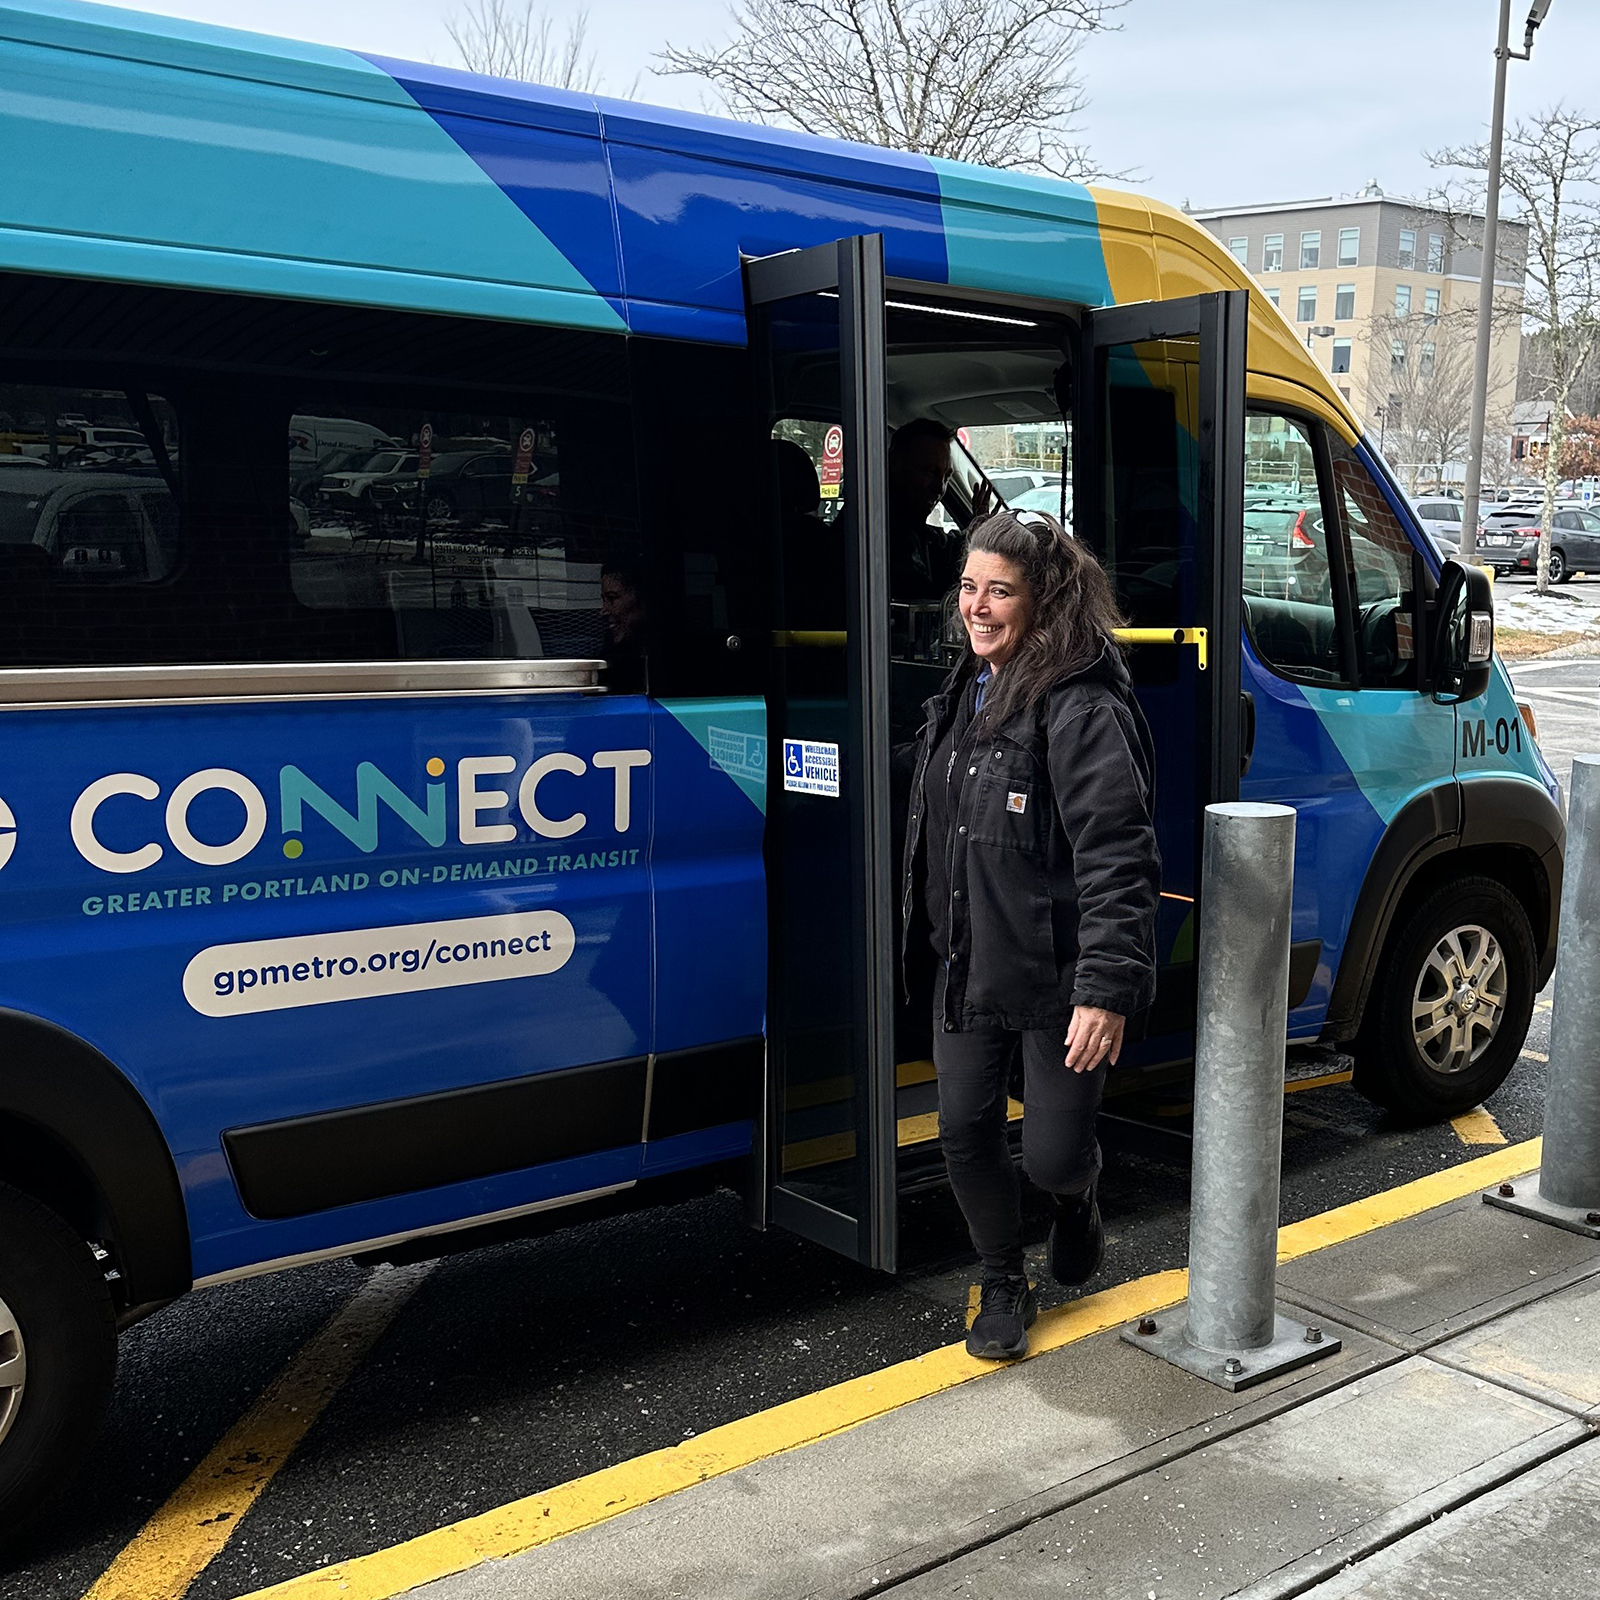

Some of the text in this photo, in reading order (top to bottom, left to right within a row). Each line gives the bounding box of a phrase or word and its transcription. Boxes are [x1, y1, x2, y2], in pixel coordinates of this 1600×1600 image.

[825, 500, 832, 514] 2
[1462, 717, 1521, 758] M-01
[805, 755, 837, 766] ACCESSIBLE
[805, 766, 837, 782] VEHICLE
[71, 749, 652, 874] CONNECT
[82, 848, 640, 917] GREATER PORTLAND ON-DEMAND TRANSIT
[213, 929, 552, 996] gpmetro.org/connect
